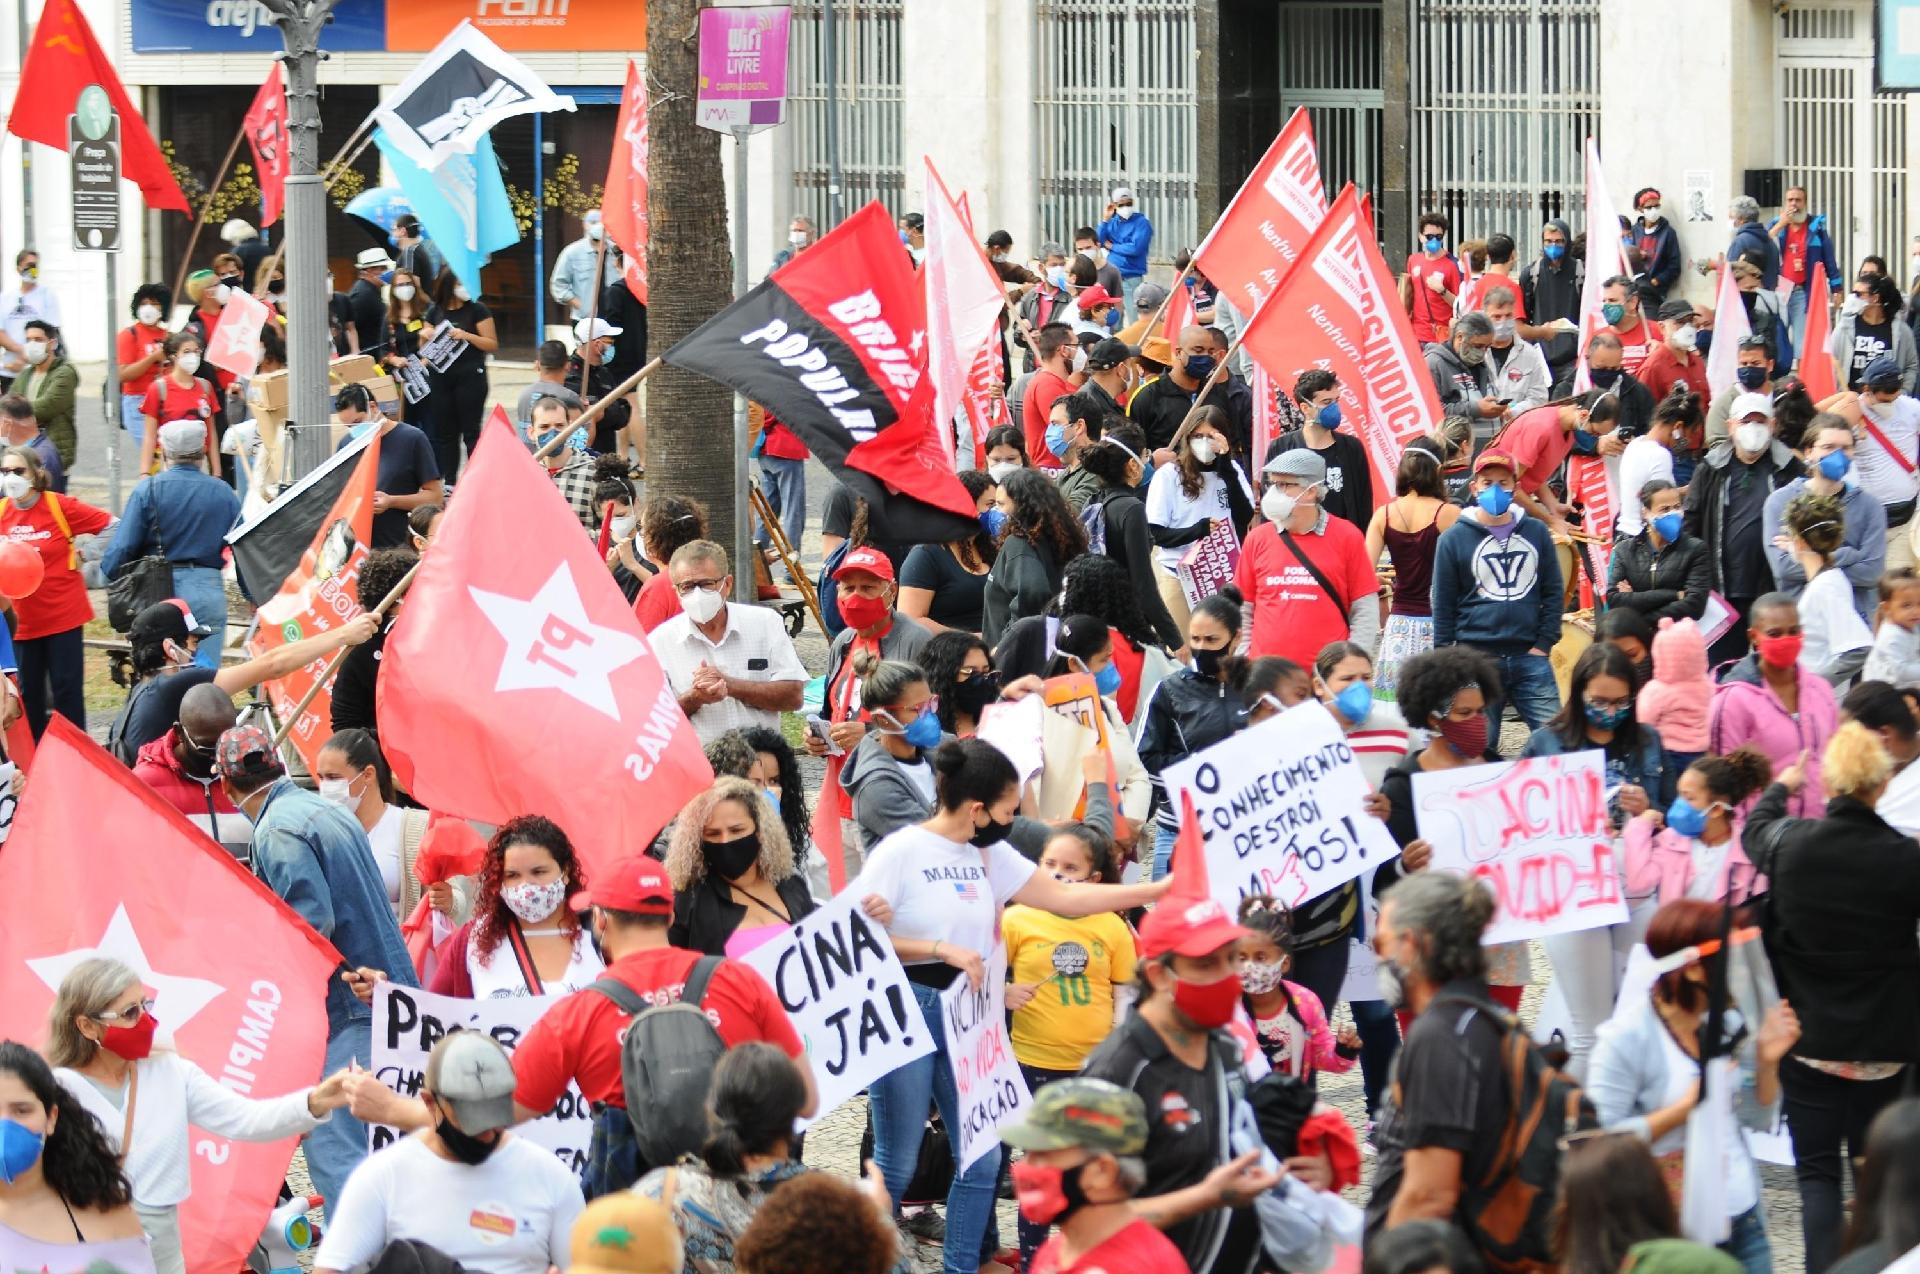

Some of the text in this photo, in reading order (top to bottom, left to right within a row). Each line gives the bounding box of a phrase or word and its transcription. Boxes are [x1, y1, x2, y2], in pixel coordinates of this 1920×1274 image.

[727, 59, 761, 75] LIVRE
[1307, 303, 1362, 364] Nenhum
[1202, 535, 1223, 580] OURÃO
[1195, 762, 1220, 795] O
[825, 977, 914, 1077] JÁ!
